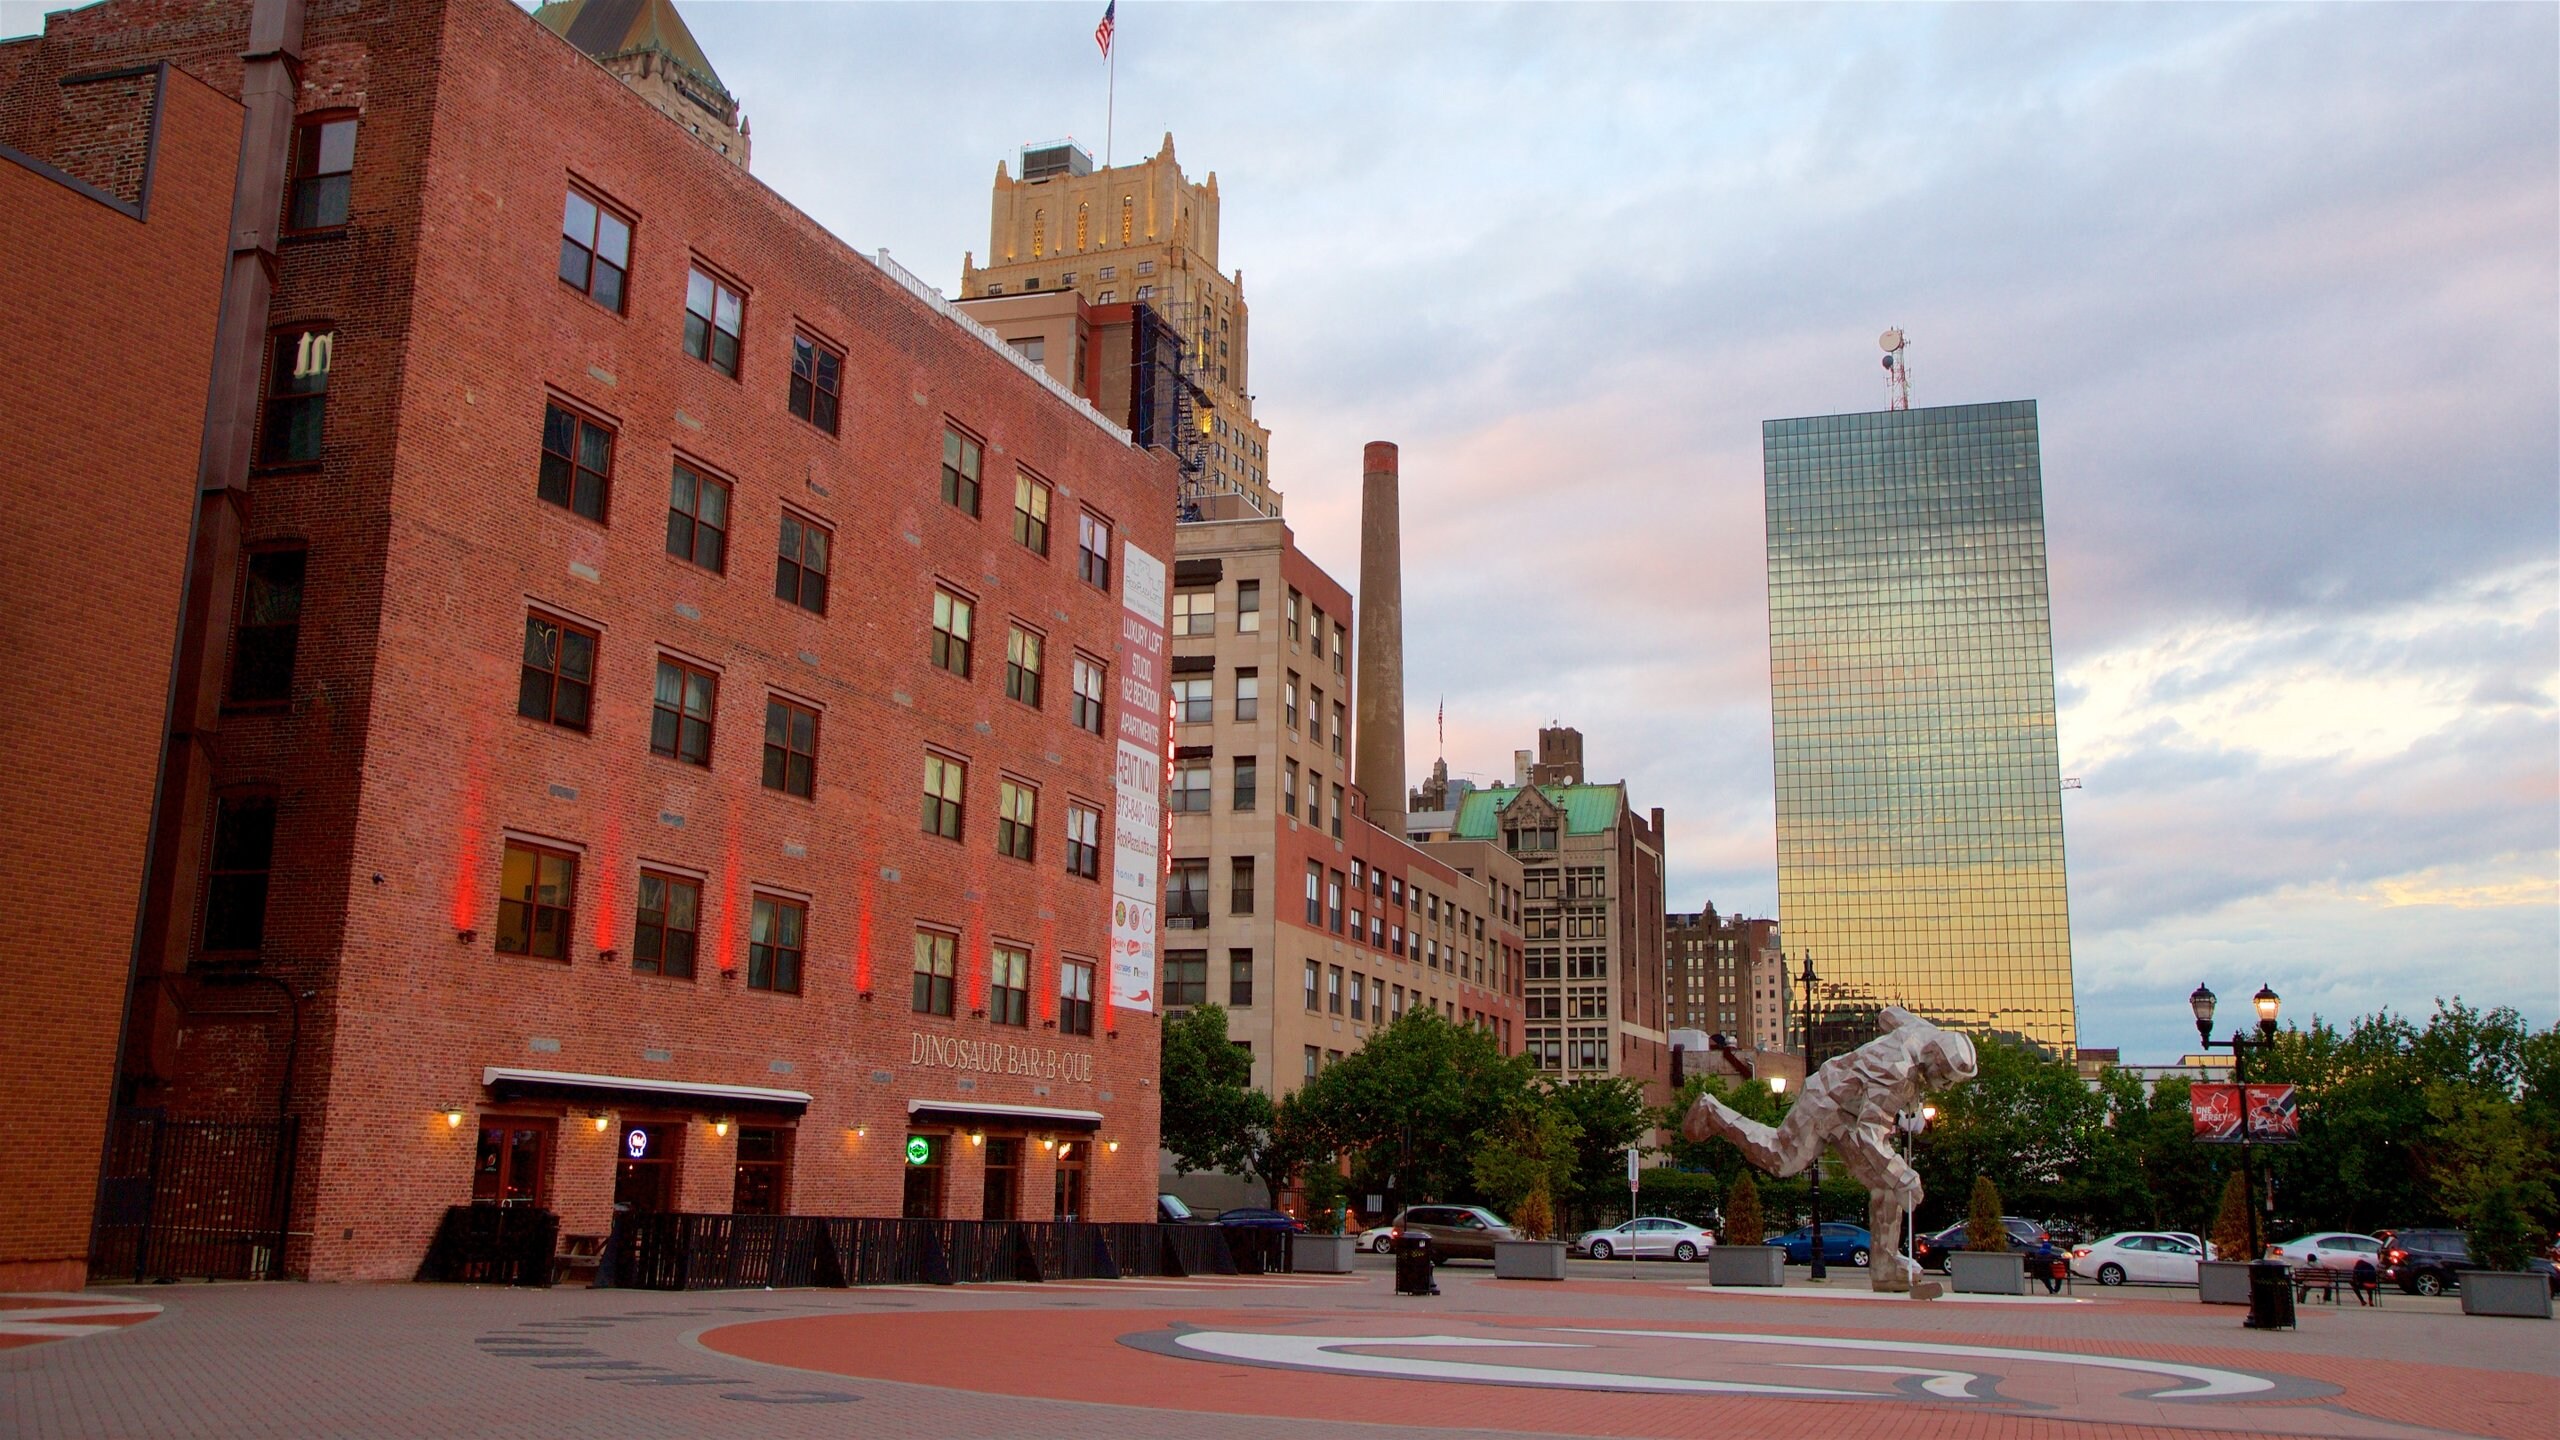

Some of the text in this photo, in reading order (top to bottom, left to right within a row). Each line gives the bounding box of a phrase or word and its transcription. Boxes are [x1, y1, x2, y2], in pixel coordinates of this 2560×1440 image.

[1124, 616, 1163, 656] LUXURY LOFT
[1133, 681, 1159, 715] BEDROOM
[1120, 711, 1159, 747] APARTMENTS
[1118, 750, 1138, 788] RENT
[911, 1032, 1003, 1073] DINOSAUR
[2196, 1106, 2211, 1114] ONE
[2199, 1113, 2227, 1122] JERSEY
